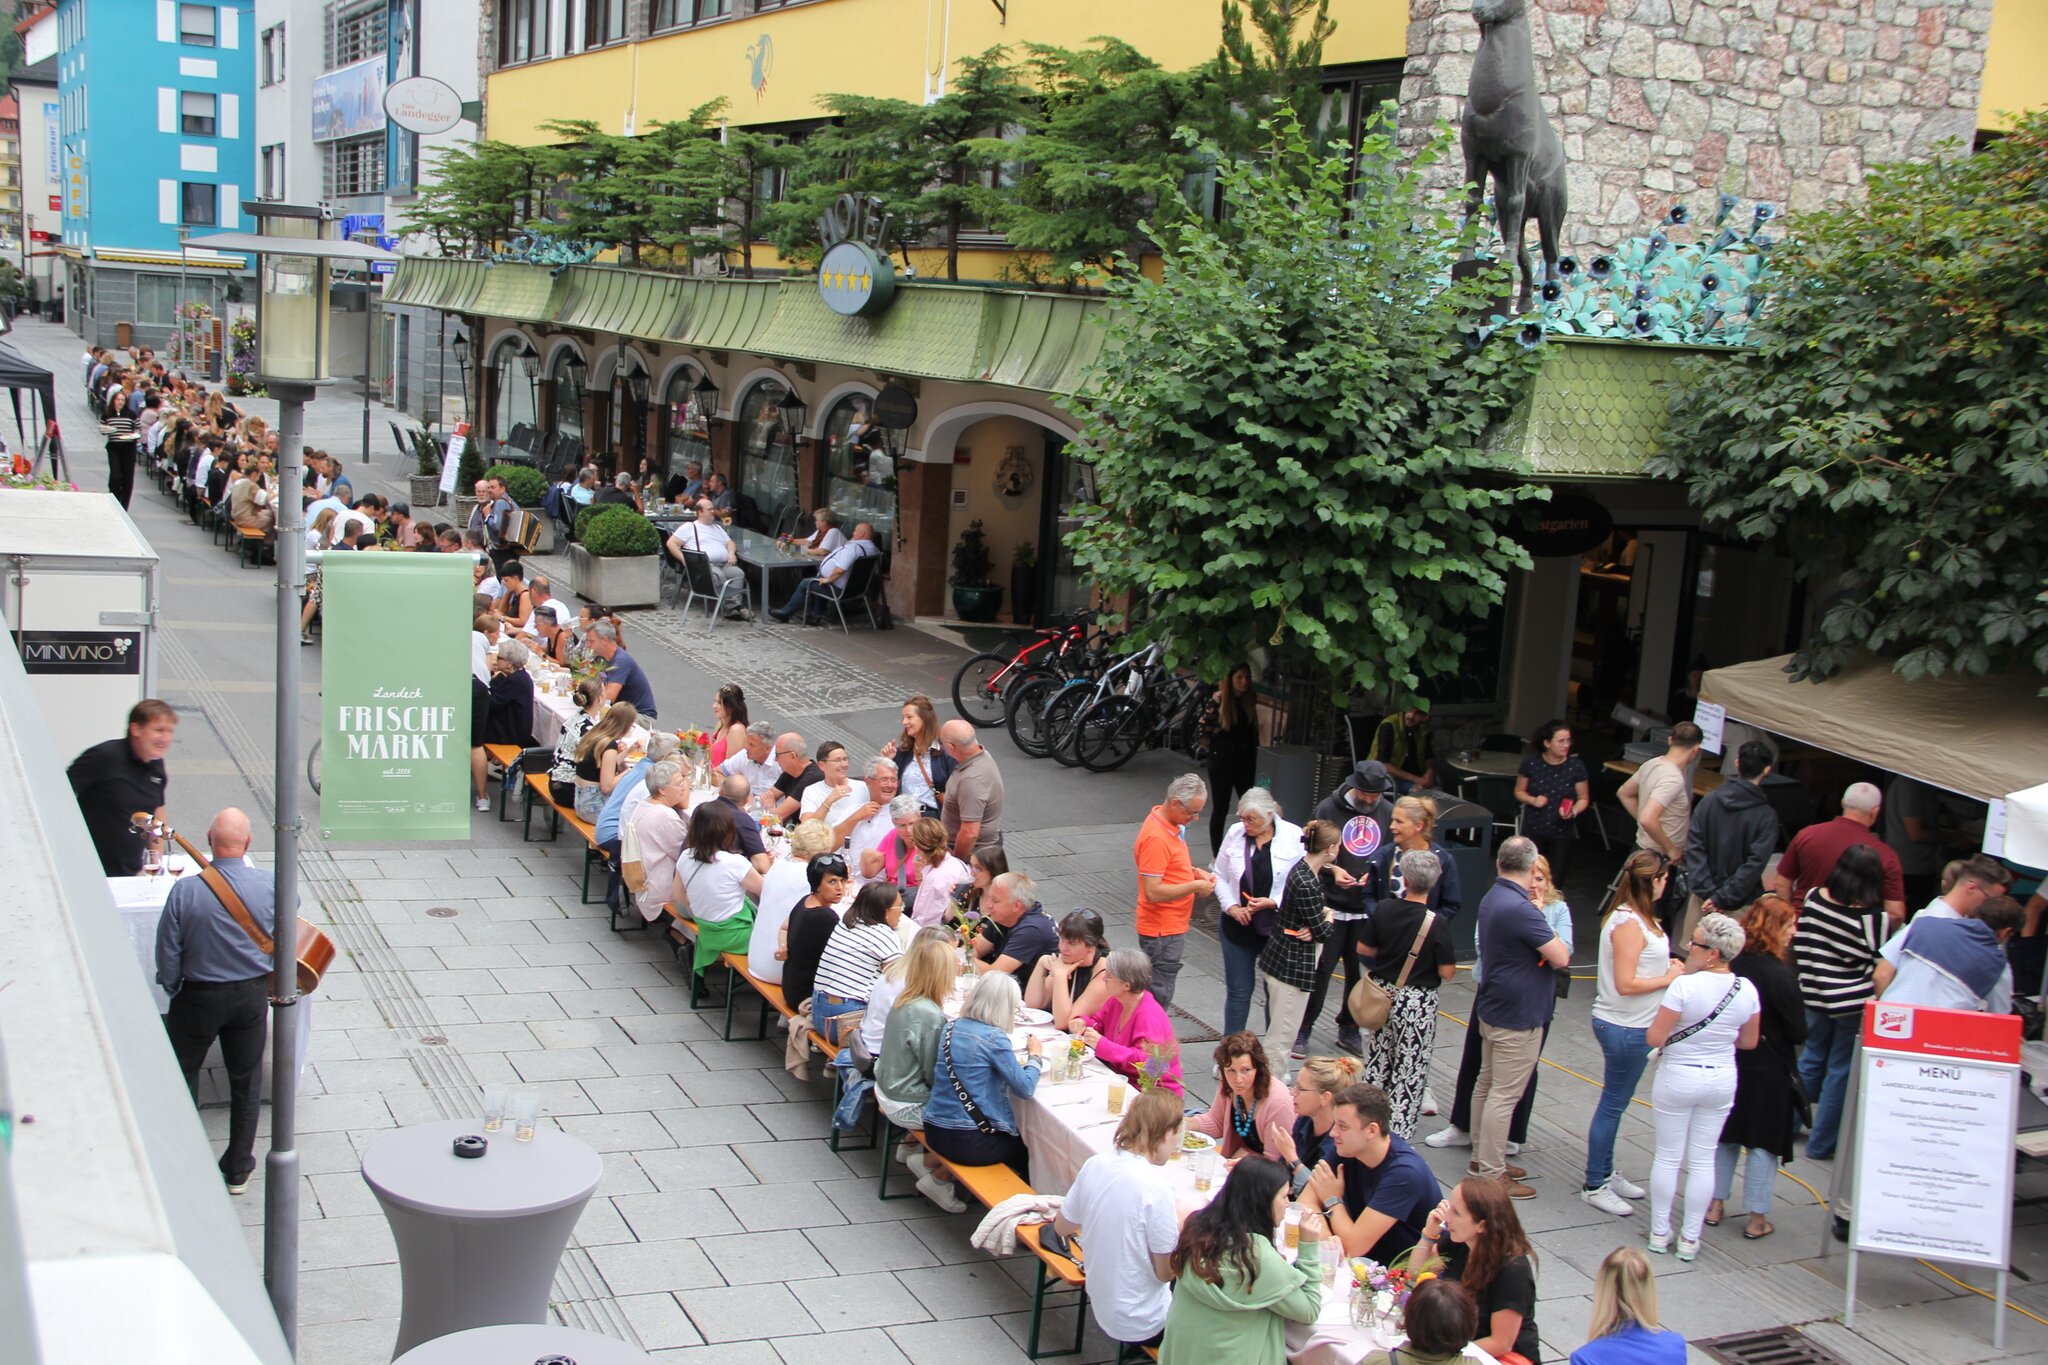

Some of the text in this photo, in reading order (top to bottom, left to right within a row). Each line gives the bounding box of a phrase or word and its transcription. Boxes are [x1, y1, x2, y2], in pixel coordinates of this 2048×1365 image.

[395, 107, 452, 123] Landegger
[70, 157, 82, 217] CAFE
[819, 191, 894, 264] HOTEL
[1540, 518, 1589, 533] stgarten
[25, 644, 113, 660] MINIVINO
[373, 686, 424, 699] Landeck
[338, 705, 456, 732] FRISCHE
[346, 733, 449, 760] MARKT
[1349, 817, 1375, 828] PARIS
[1880, 1011, 1907, 1025] Stiegl
[1919, 1065, 1963, 1081] MENÜ
